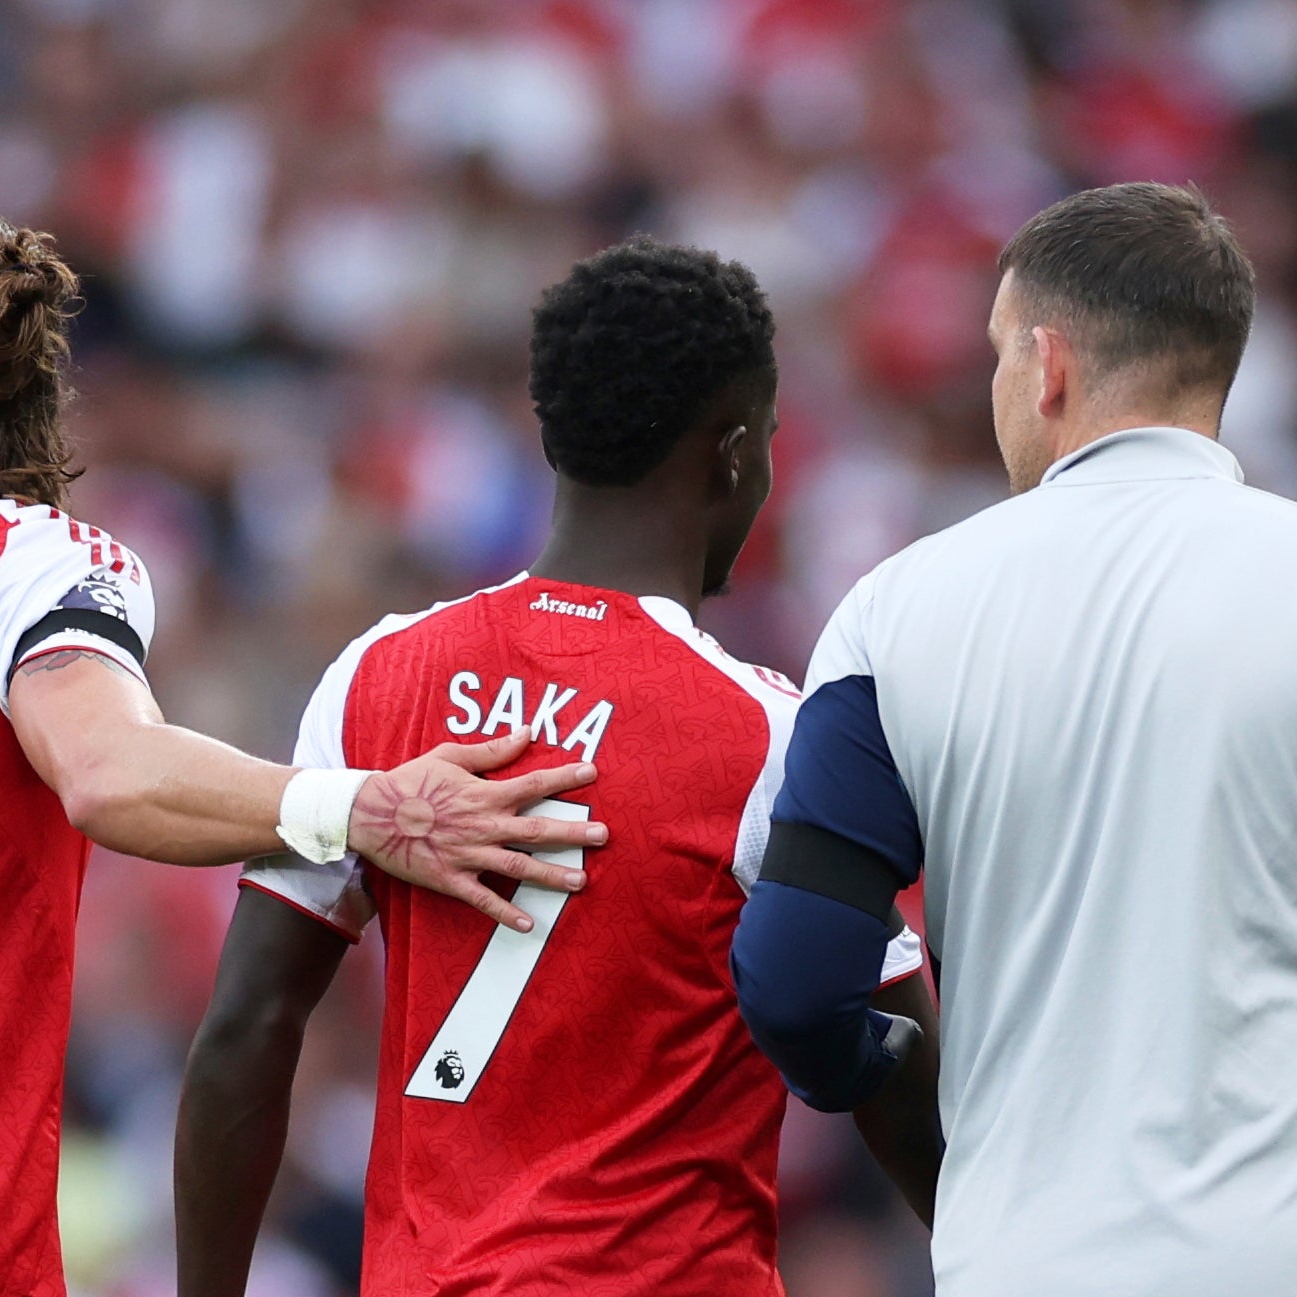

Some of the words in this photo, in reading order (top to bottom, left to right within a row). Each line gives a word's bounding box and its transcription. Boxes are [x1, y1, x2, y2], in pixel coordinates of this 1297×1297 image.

[529, 592, 608, 621] Arsenal
[445, 669, 614, 764] SAKA
[403, 796, 592, 1103] 7
